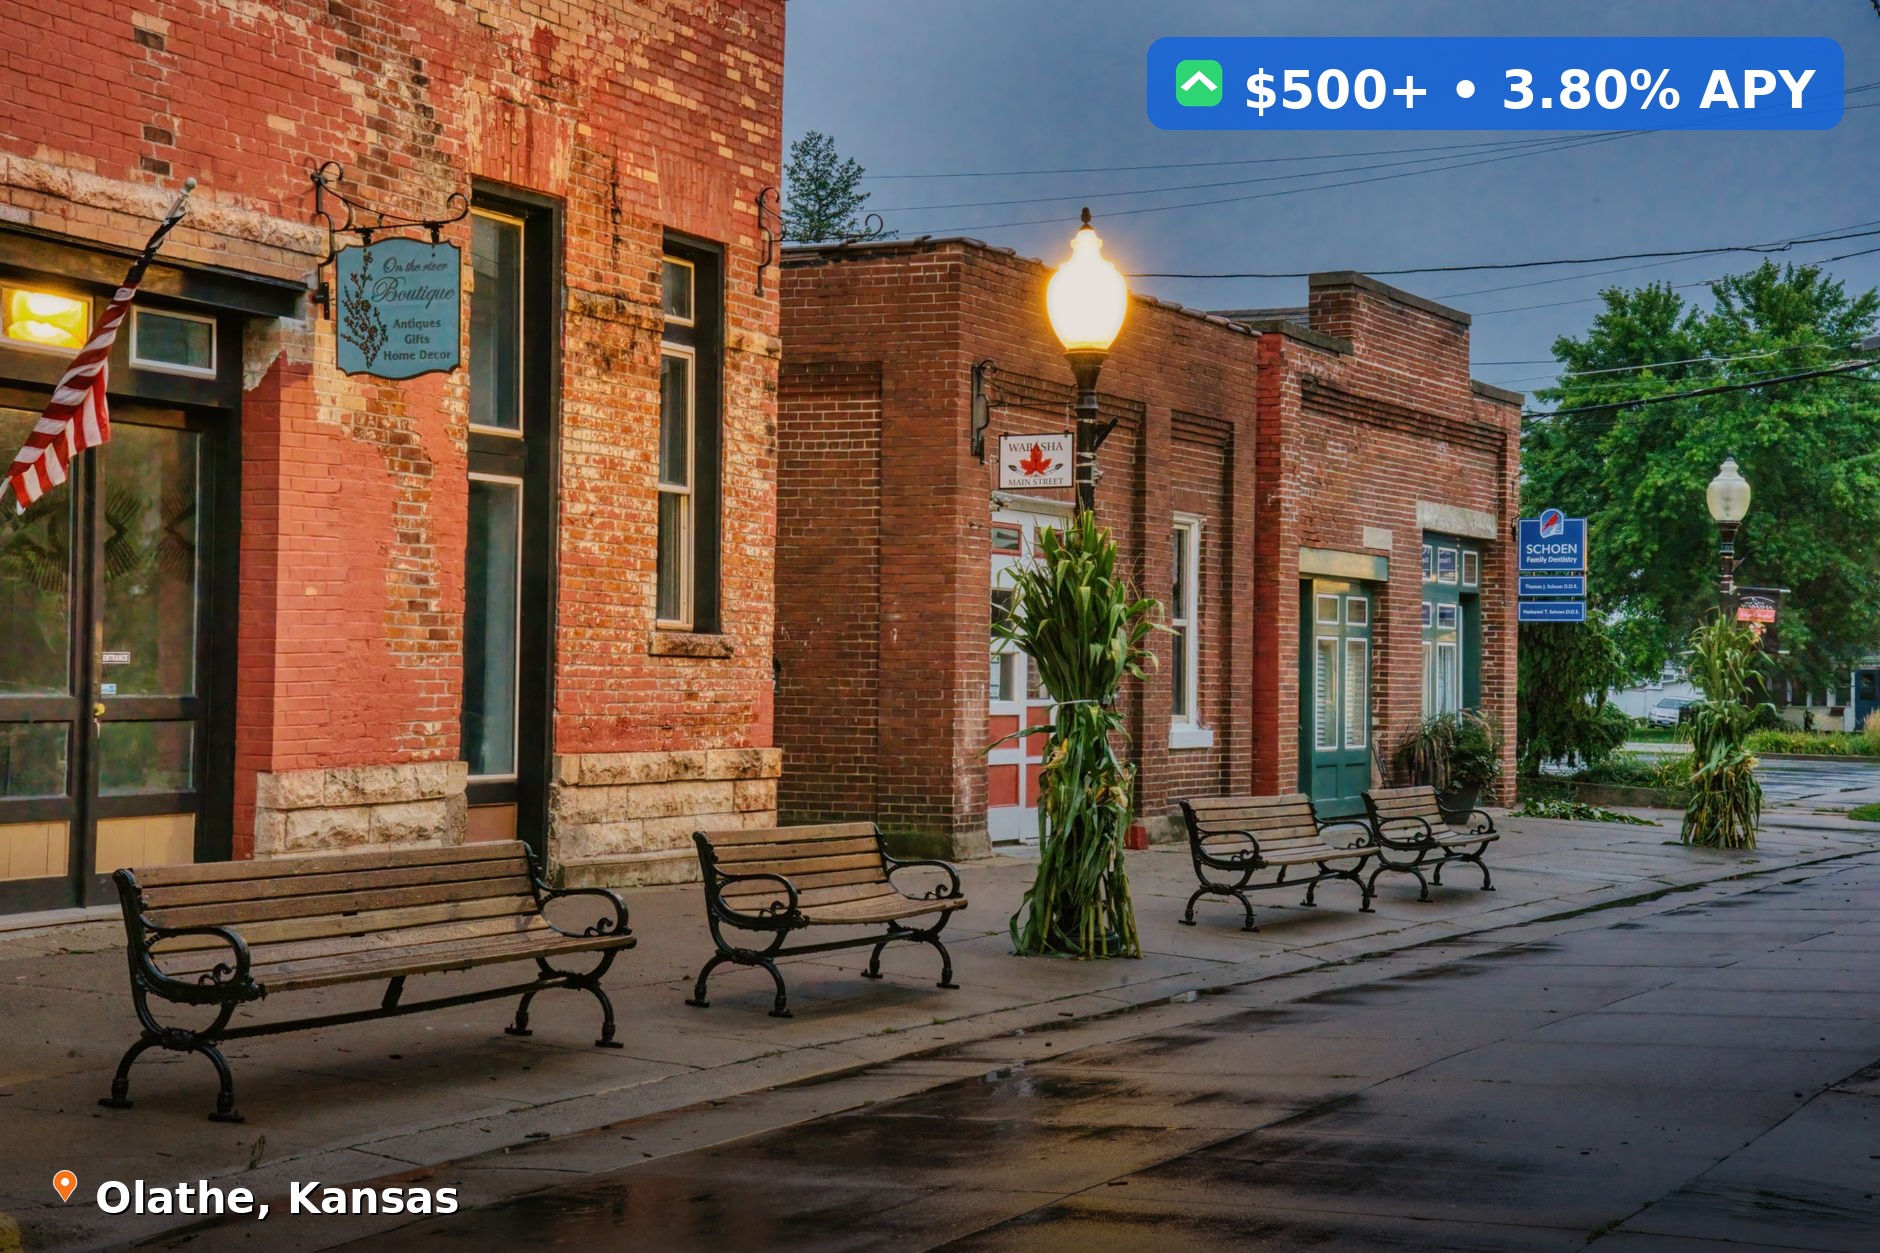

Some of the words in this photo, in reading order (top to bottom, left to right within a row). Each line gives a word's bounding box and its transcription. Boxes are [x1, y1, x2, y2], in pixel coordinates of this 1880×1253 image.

[383, 257, 403, 273] On
[405, 258, 421, 272] the
[422, 262, 448, 272] river
[371, 276, 455, 310] Boutique
[393, 318, 441, 330] Antiques
[404, 334, 430, 344] Gifts
[383, 350, 416, 361] Home
[419, 350, 452, 361] Decor
[1008, 441, 1063, 452] WABASHA
[1032, 478, 1064, 486] STREET
[1526, 544, 1577, 554] SCHOEN
[1526, 556, 1547, 564] Family
[1548, 555, 1577, 564] Dentistry
